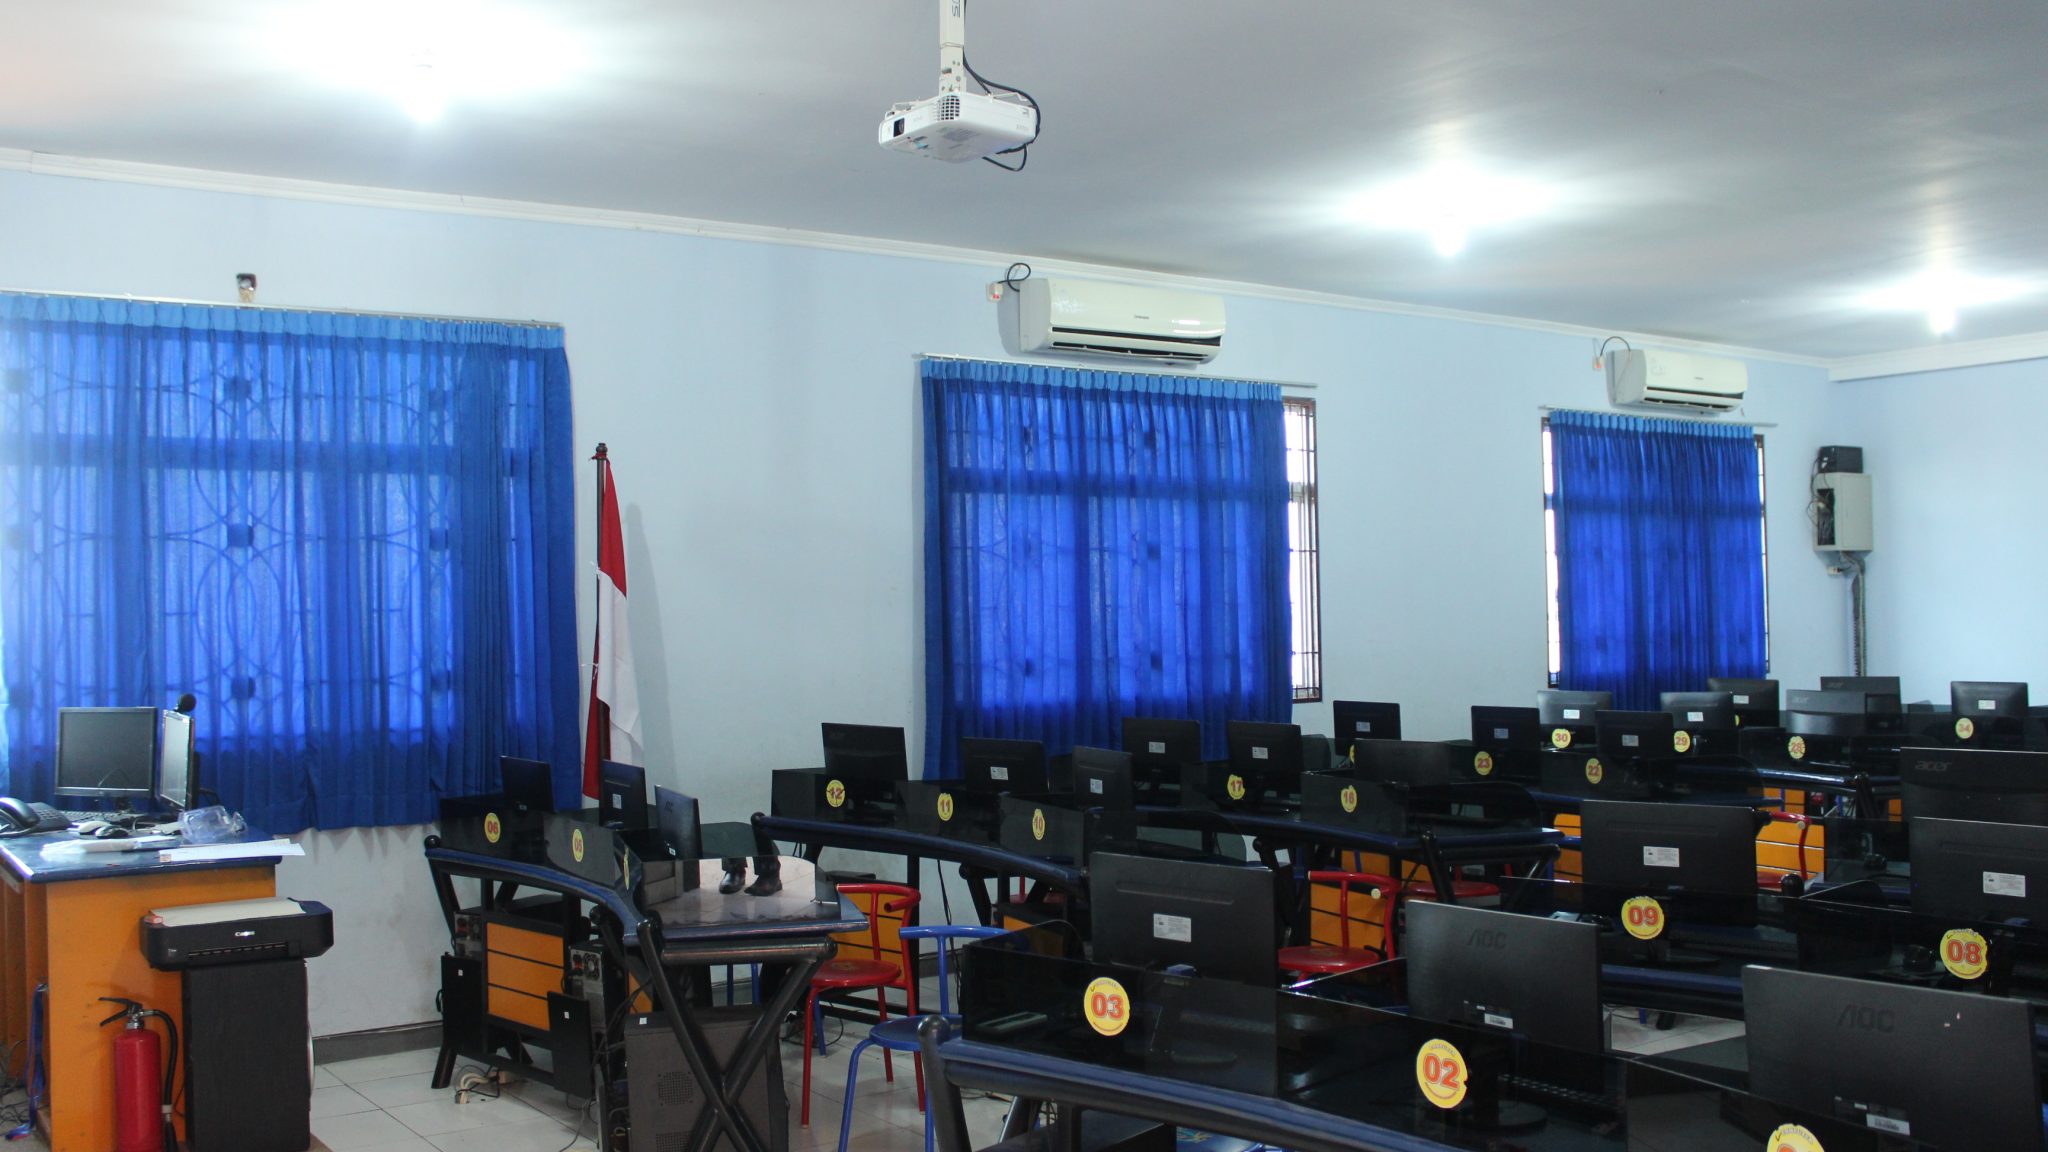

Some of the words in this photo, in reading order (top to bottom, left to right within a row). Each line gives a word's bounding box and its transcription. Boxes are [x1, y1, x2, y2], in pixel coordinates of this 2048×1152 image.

[1555, 733, 1568, 742] 30
[1675, 736, 1687, 746] 29
[1477, 758, 1490, 769] 23
[1915, 761, 1952, 771] acer
[1588, 765, 1600, 777] 22
[1231, 780, 1242, 792] 17
[831, 787, 842, 800] 12
[941, 799, 950, 812] 11
[487, 821, 499, 834] 06
[1628, 906, 1659, 927] 09
[1466, 929, 1507, 949] AOC
[1947, 939, 1982, 966] 08
[1091, 991, 1125, 1020] 03
[1836, 1004, 1896, 1033] AOC
[1423, 1053, 1460, 1091] 02
